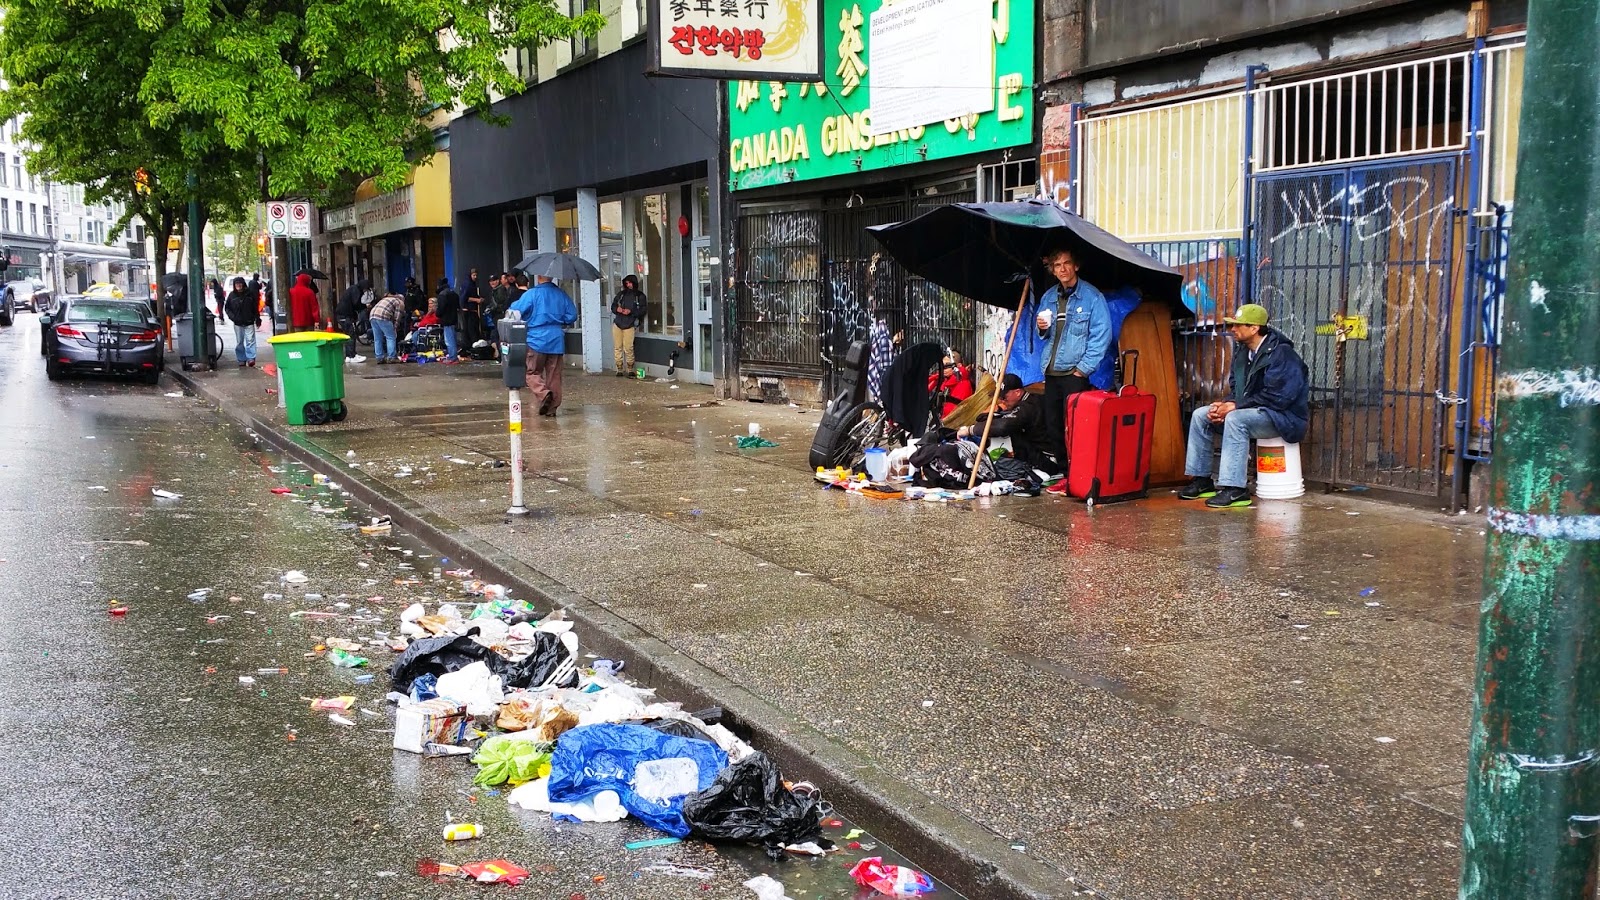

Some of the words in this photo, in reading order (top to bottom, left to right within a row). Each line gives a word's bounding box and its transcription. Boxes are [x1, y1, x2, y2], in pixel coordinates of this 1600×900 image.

[872, 9, 904, 27] DEVELOPMENT
[905, 0, 936, 15] APPLICATION
[903, 17, 916, 26] Street
[730, 123, 810, 173] CANADA
